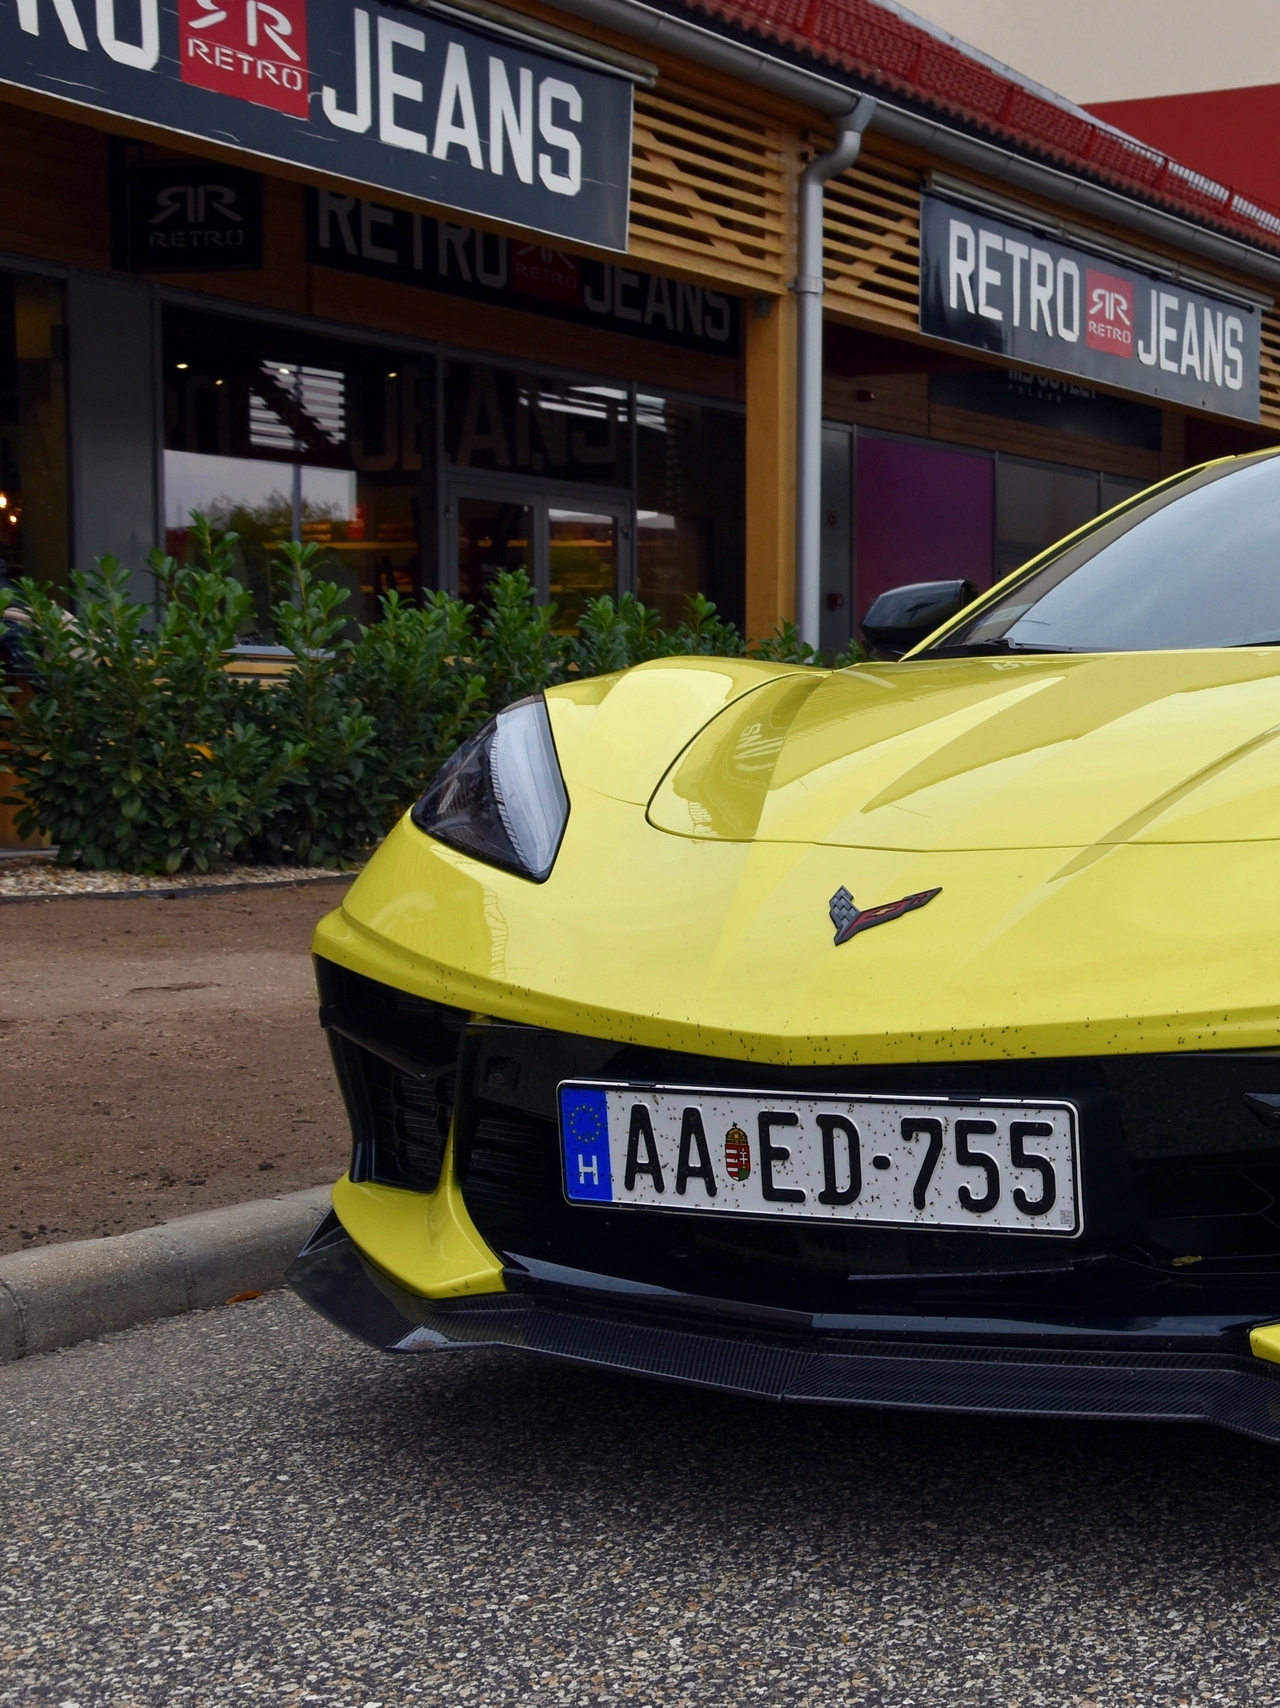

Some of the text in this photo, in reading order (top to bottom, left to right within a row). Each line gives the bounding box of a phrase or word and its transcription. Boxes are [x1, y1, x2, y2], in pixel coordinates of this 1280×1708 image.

[187, 38, 302, 91] RETRO
[321, 8, 582, 196] JEANS
[149, 230, 244, 249] RETRO
[515, 262, 578, 290] RETRO
[583, 262, 731, 342] JEANS
[949, 219, 1244, 391] RETRO JEANS
[1088, 322, 1131, 344] RETRO
[577, 1153, 600, 1186] H
[623, 1102, 1058, 1217] AA ED-755
